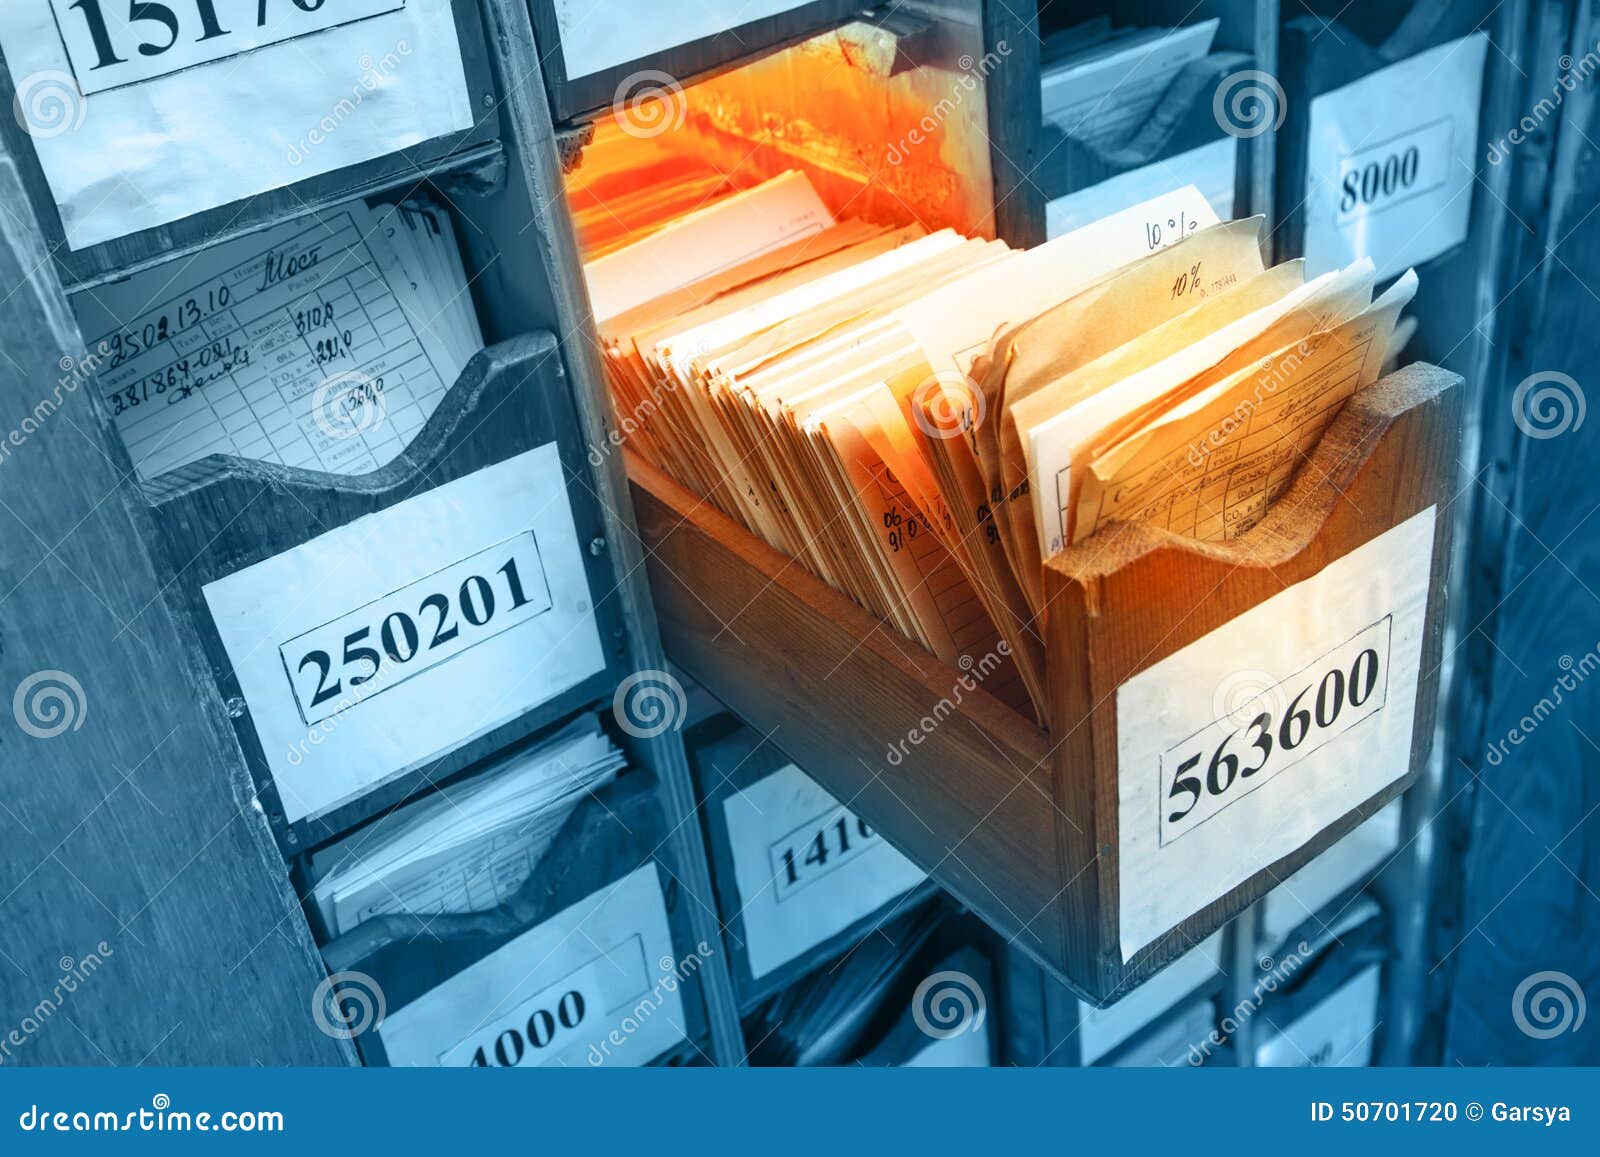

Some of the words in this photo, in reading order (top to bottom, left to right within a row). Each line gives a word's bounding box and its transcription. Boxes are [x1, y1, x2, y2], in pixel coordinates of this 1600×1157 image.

[69, 0, 325, 70] 151
[1341, 145, 1418, 213] 8000
[1171, 261, 1201, 300] 10%
[298, 557, 534, 708] 250201
[1169, 649, 1379, 823] 563600
